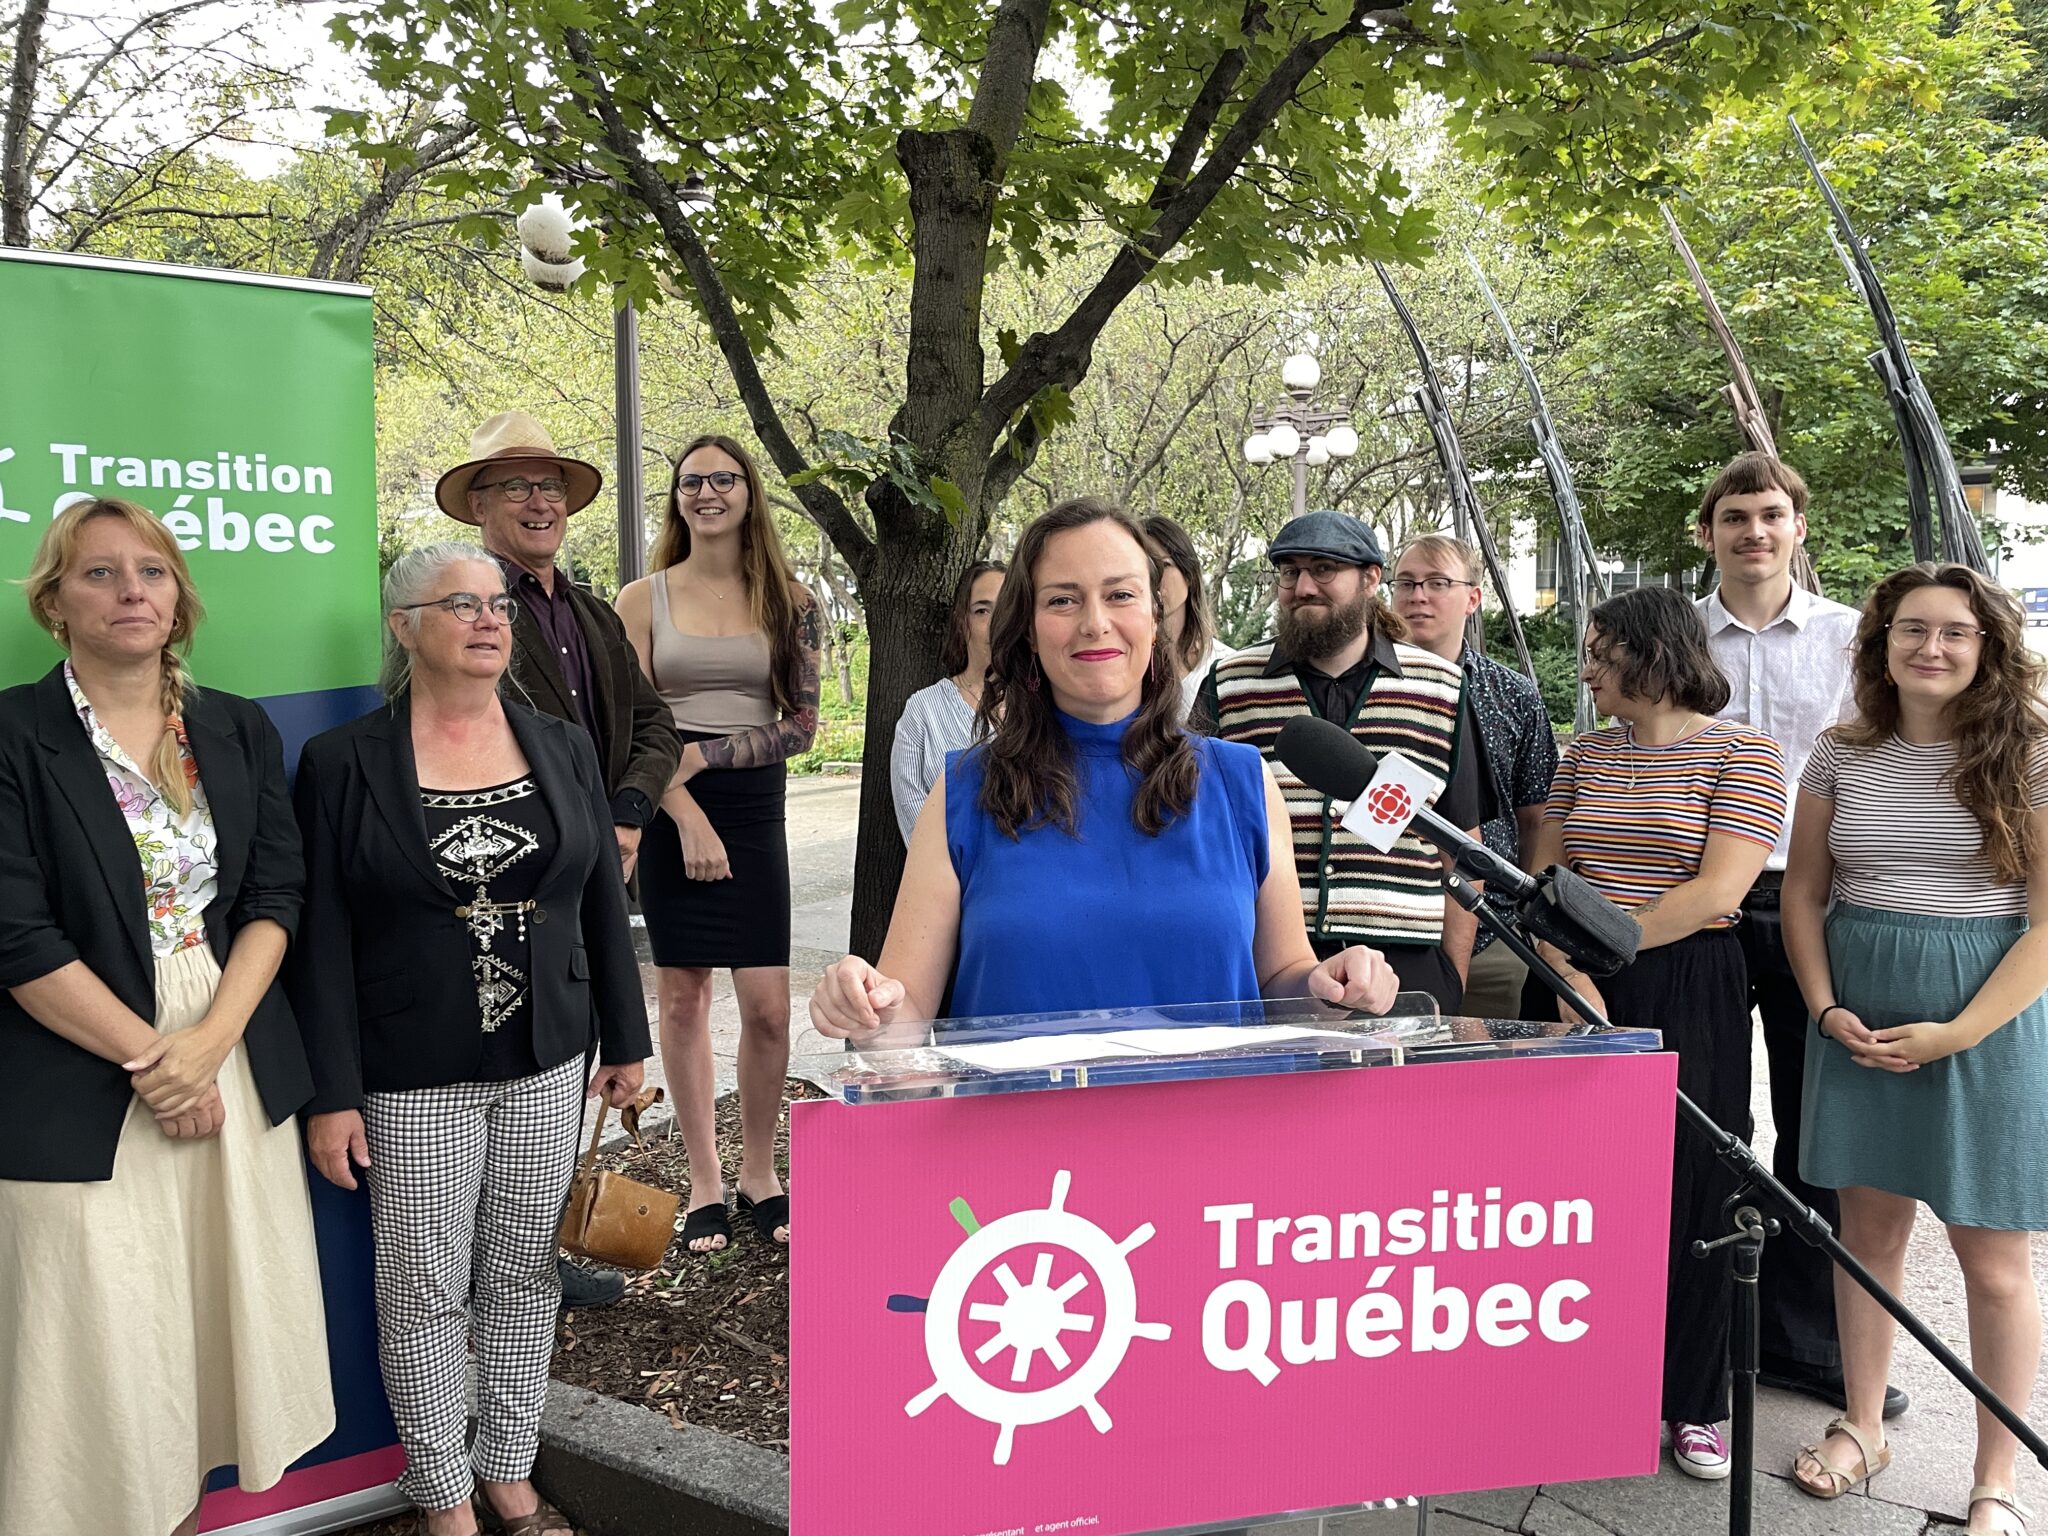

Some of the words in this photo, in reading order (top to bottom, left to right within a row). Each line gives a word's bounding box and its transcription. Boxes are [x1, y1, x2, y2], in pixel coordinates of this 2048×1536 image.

[50, 443, 333, 495] Transition
[53, 492, 336, 554] ébec
[1203, 1186, 1594, 1270] Transition
[1202, 1265, 1591, 1387] Québec
[1034, 1524, 1043, 1533] et
[1044, 1520, 1069, 1533] agent
[1070, 1515, 1100, 1527] officiel.
